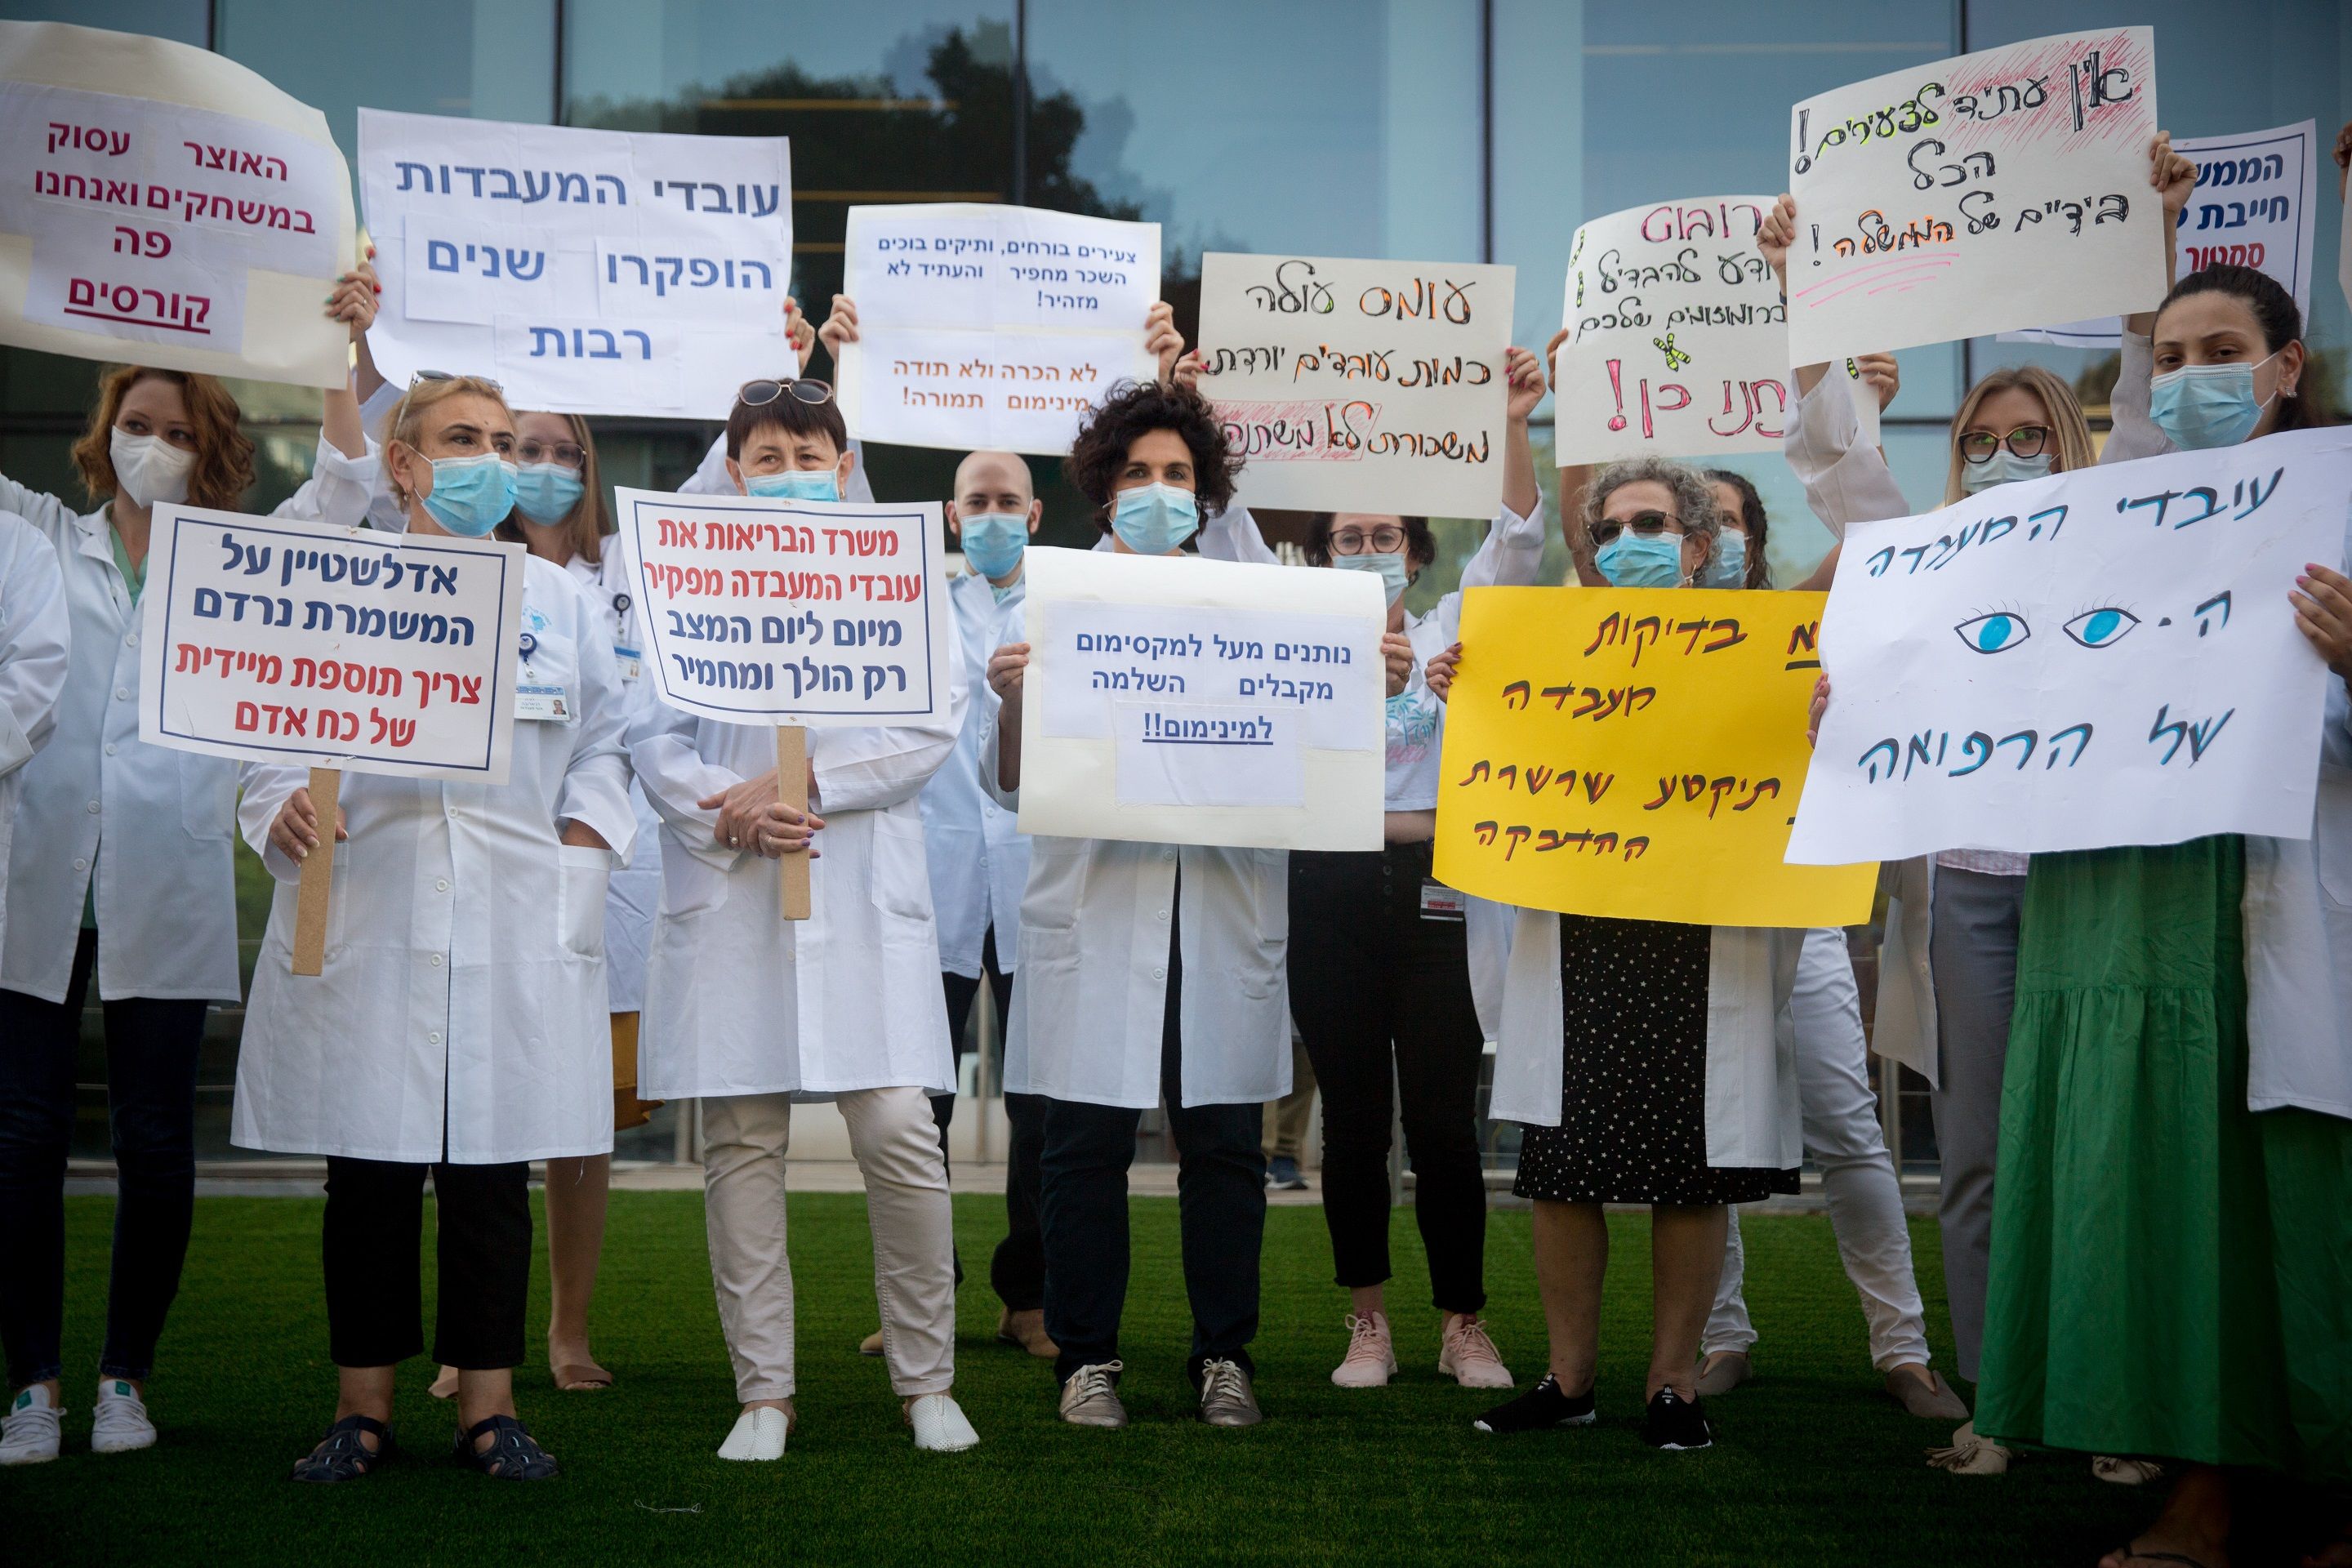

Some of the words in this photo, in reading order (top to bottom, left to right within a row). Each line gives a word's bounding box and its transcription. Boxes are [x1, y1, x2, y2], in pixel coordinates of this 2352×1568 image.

[1953, 75, 2049, 120] עתיד
[2069, 51, 2132, 132] אין
[48, 122, 131, 156] עסוק
[184, 141, 287, 181] האוצר
[1908, 138, 1995, 190] הכל
[2194, 154, 2283, 188] הממש
[35, 171, 138, 206] ואנחנו
[394, 161, 626, 205] המעבדות
[653, 180, 779, 218] עובדי
[147, 186, 316, 234] במשחקים
[1641, 203, 1762, 243] רובוט
[1959, 190, 2001, 234] של
[2015, 194, 2129, 237] בידיים
[2197, 195, 2289, 230] חייבת
[114, 226, 172, 258] פה
[878, 236, 927, 252] בוכים
[934, 237, 994, 256] ותיקים
[1078, 246, 1137, 264] צעירים
[428, 240, 545, 281] שנים
[608, 254, 772, 296] הופקרו
[887, 260, 911, 275] לא
[918, 263, 983, 278] והעתיד
[1009, 265, 1067, 282] מחפיר
[1075, 268, 1127, 285] השכר
[1598, 247, 1701, 293] להבדיל
[1718, 252, 1771, 285] ודע
[69, 278, 211, 327] קורסים
[1037, 290, 1098, 310] מזהיר!
[1245, 261, 1334, 314] עולה
[1360, 278, 1476, 324] עומס
[1576, 296, 1652, 344] שלכם
[529, 327, 651, 359] רבות
[893, 359, 949, 377] תודה
[958, 359, 994, 378] ולא
[1000, 363, 1060, 381] הכרה
[1069, 362, 1098, 382] לא
[1205, 346, 1285, 376] יורדת
[1294, 344, 1396, 383] עובדים
[1398, 356, 1491, 387] כמות
[902, 386, 984, 408] תמורה!
[1007, 393, 1089, 412] מינימום
[1325, 401, 1374, 451] לא
[1367, 430, 1489, 463] משכורת
[2116, 466, 2284, 531] עובדי
[657, 519, 697, 549] את
[704, 522, 815, 554] הבריאות
[822, 528, 898, 557] משרד
[1864, 504, 2069, 577] המעבדה
[222, 533, 271, 575] על
[280, 548, 458, 596] אדלשטיין
[644, 562, 724, 599] מפקיר
[731, 570, 842, 601] המעבדה
[849, 573, 921, 603] עובדי
[194, 587, 292, 627] נרדם
[302, 600, 474, 646] המשמרת
[666, 609, 751, 644] המצב
[762, 610, 823, 645] ליום
[834, 618, 902, 647] מיום
[1584, 611, 1748, 667] בדיקות
[175, 644, 283, 684] מיידית
[1076, 632, 1203, 661] למקסימום
[1213, 634, 1263, 661] מעל
[1274, 642, 1352, 665] נותנים
[290, 657, 403, 697] תוספת
[412, 670, 482, 709] צריך
[671, 653, 773, 691] ומחמיר
[783, 655, 853, 700] הולך
[862, 664, 906, 701] רק
[1092, 667, 1186, 694] השלמה
[1239, 674, 1334, 704] מקבלים
[1502, 679, 1657, 722] מעבדה
[235, 701, 307, 737] אדם
[316, 709, 359, 742] כח
[370, 706, 416, 747] של
[1143, 712, 1273, 740] למינימום!!
[2148, 703, 2235, 768] של
[1858, 722, 2094, 785] הרפואה
[1459, 760, 1615, 804] שרשרת
